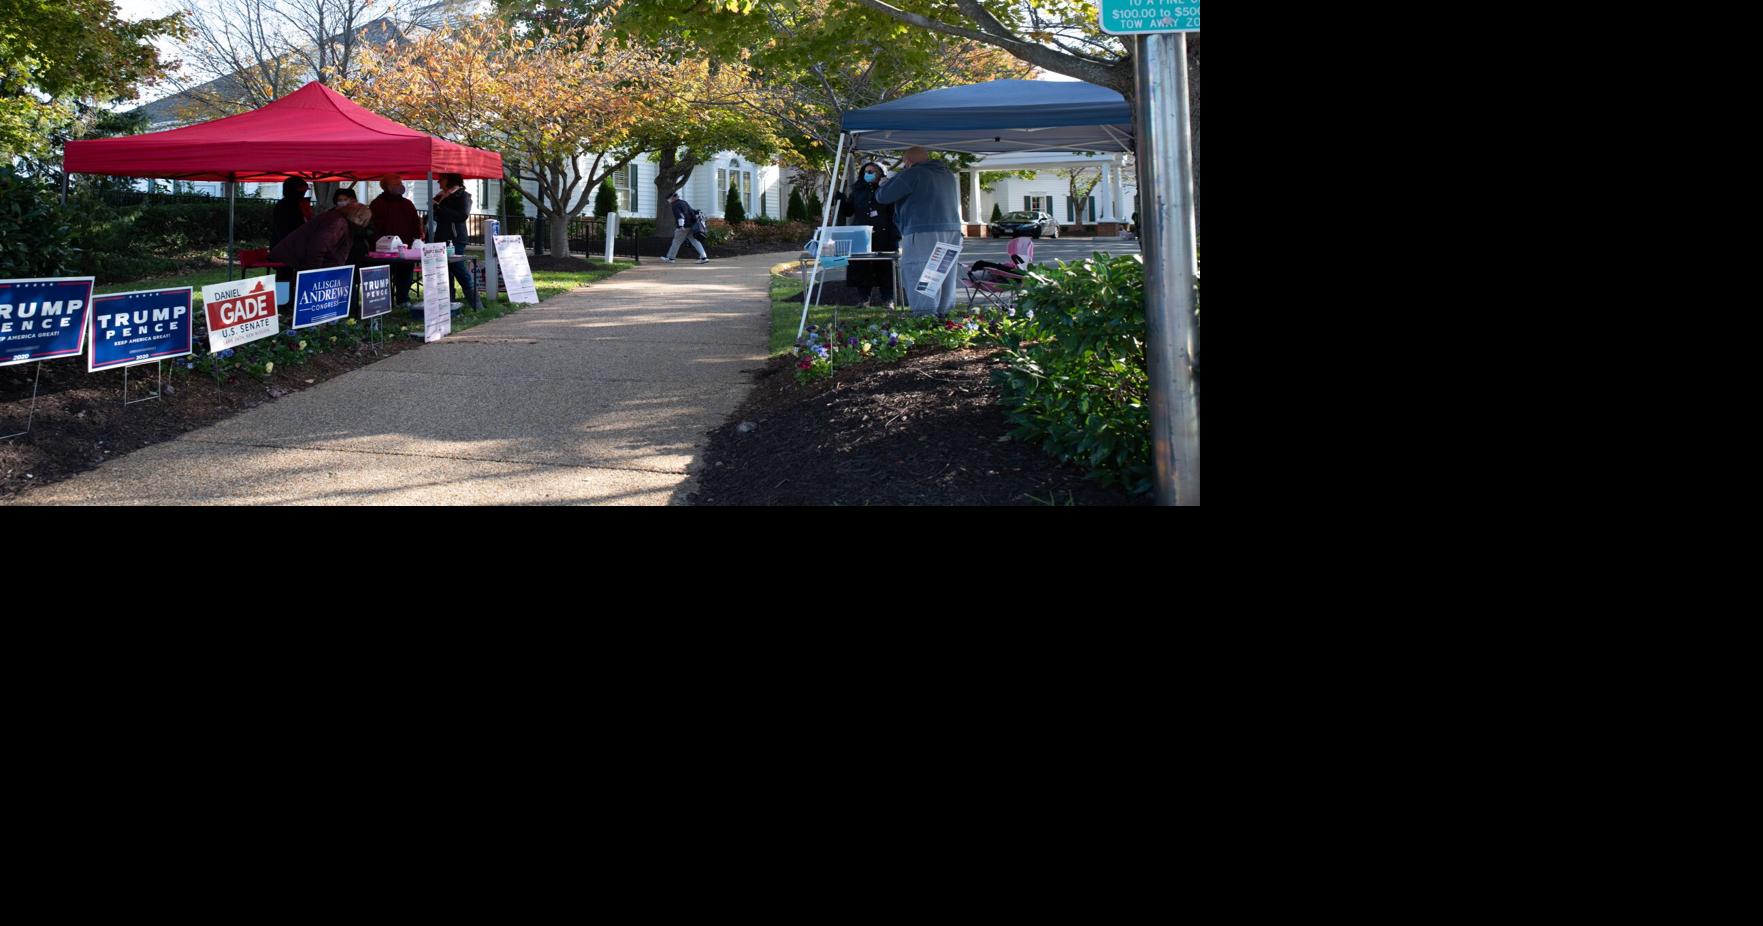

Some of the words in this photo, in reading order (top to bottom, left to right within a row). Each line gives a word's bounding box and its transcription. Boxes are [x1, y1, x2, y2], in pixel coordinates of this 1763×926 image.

[1112, 8, 1156, 19] $100.00
[1160, 9, 1171, 17] to
[1120, 19, 1143, 29] TOW
[312, 279, 341, 291] ALISCIA
[363, 278, 389, 291] TRUMP
[214, 288, 242, 301] DANIEL
[299, 286, 349, 304] ANDREWS
[366, 288, 388, 299] PENCE
[220, 295, 268, 325] GADE
[311, 300, 339, 312] CONGRESS
[97, 305, 186, 329] TRUMP
[106, 321, 178, 340] PENCE
[222, 327, 238, 338] U.S.
[240, 319, 270, 333] SENATE
[7, 333, 36, 341] AMERICA
[129, 336, 152, 344] AMERICA
[12, 353, 30, 361] 2020
